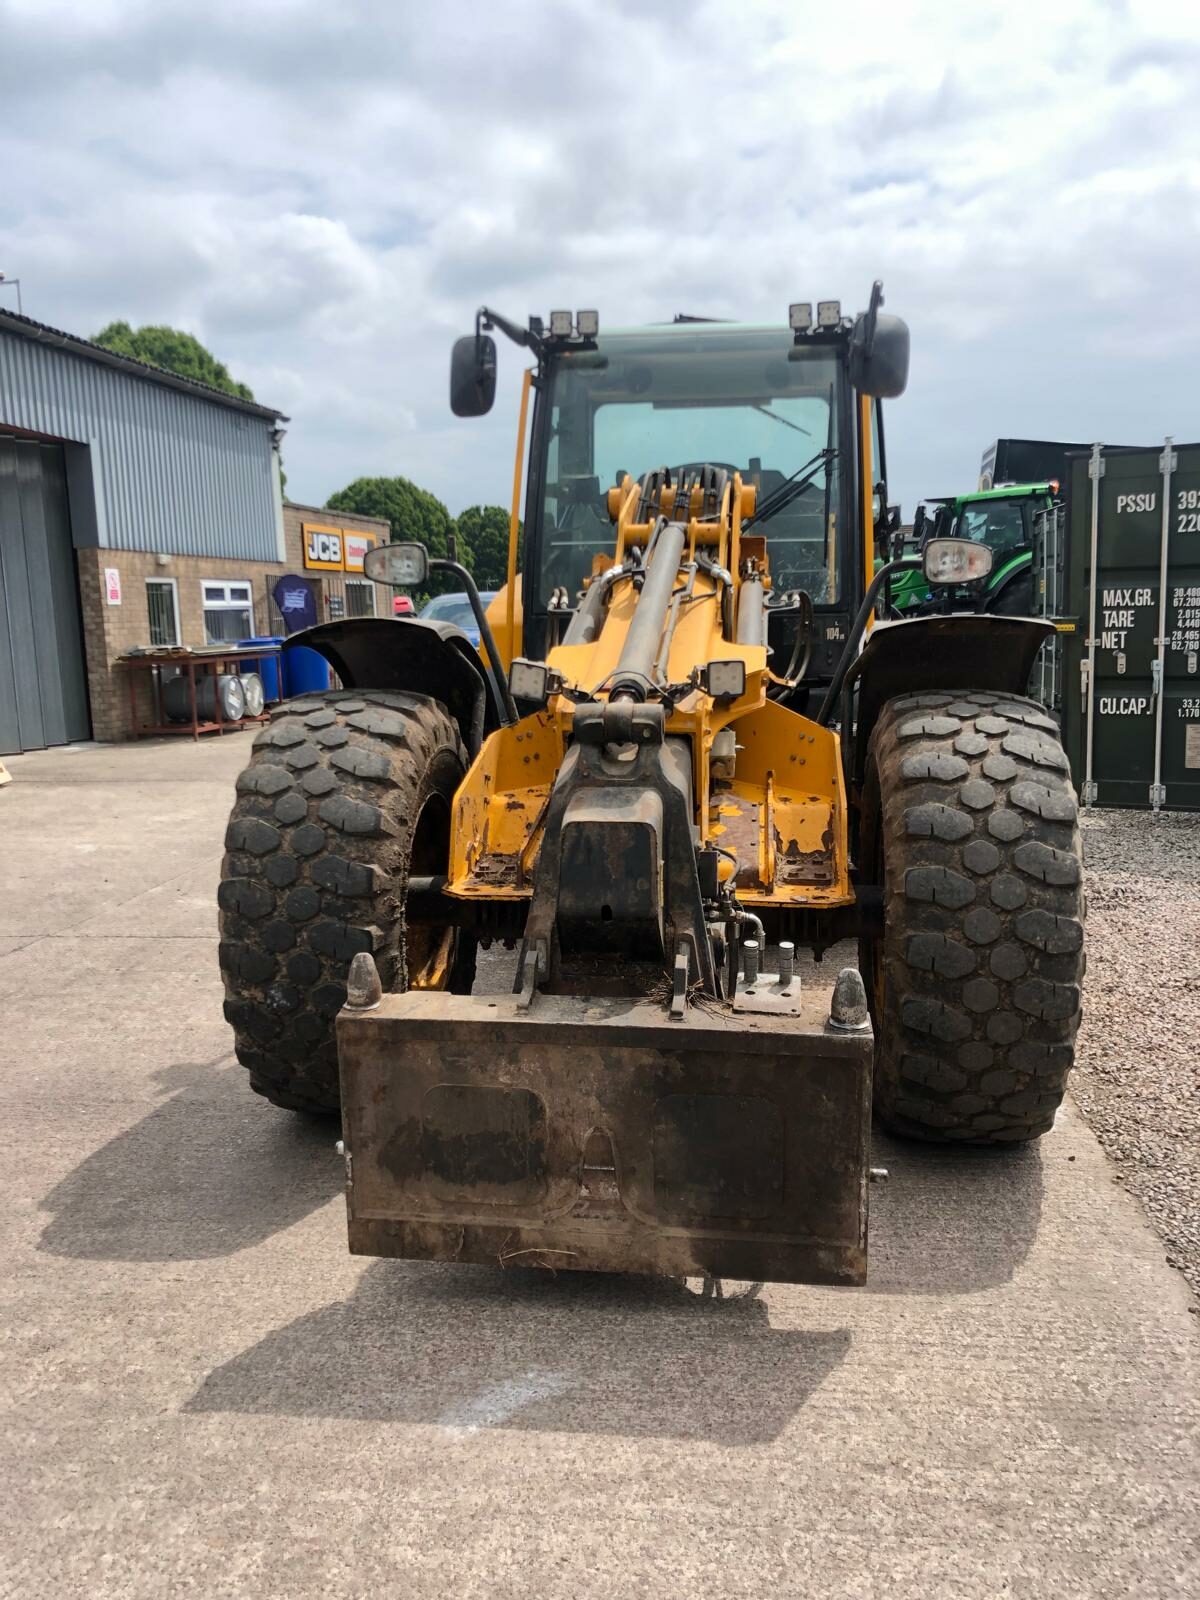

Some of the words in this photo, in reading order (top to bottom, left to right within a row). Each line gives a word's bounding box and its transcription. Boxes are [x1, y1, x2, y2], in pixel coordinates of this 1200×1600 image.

[1117, 493, 1155, 513] PSSU
[309, 533, 342, 562] JCB
[1103, 588, 1155, 608] MAX.GR.
[1103, 610, 1135, 628] TARE
[1101, 631, 1127, 650] NET
[1099, 698, 1151, 716] CU.CAP.
